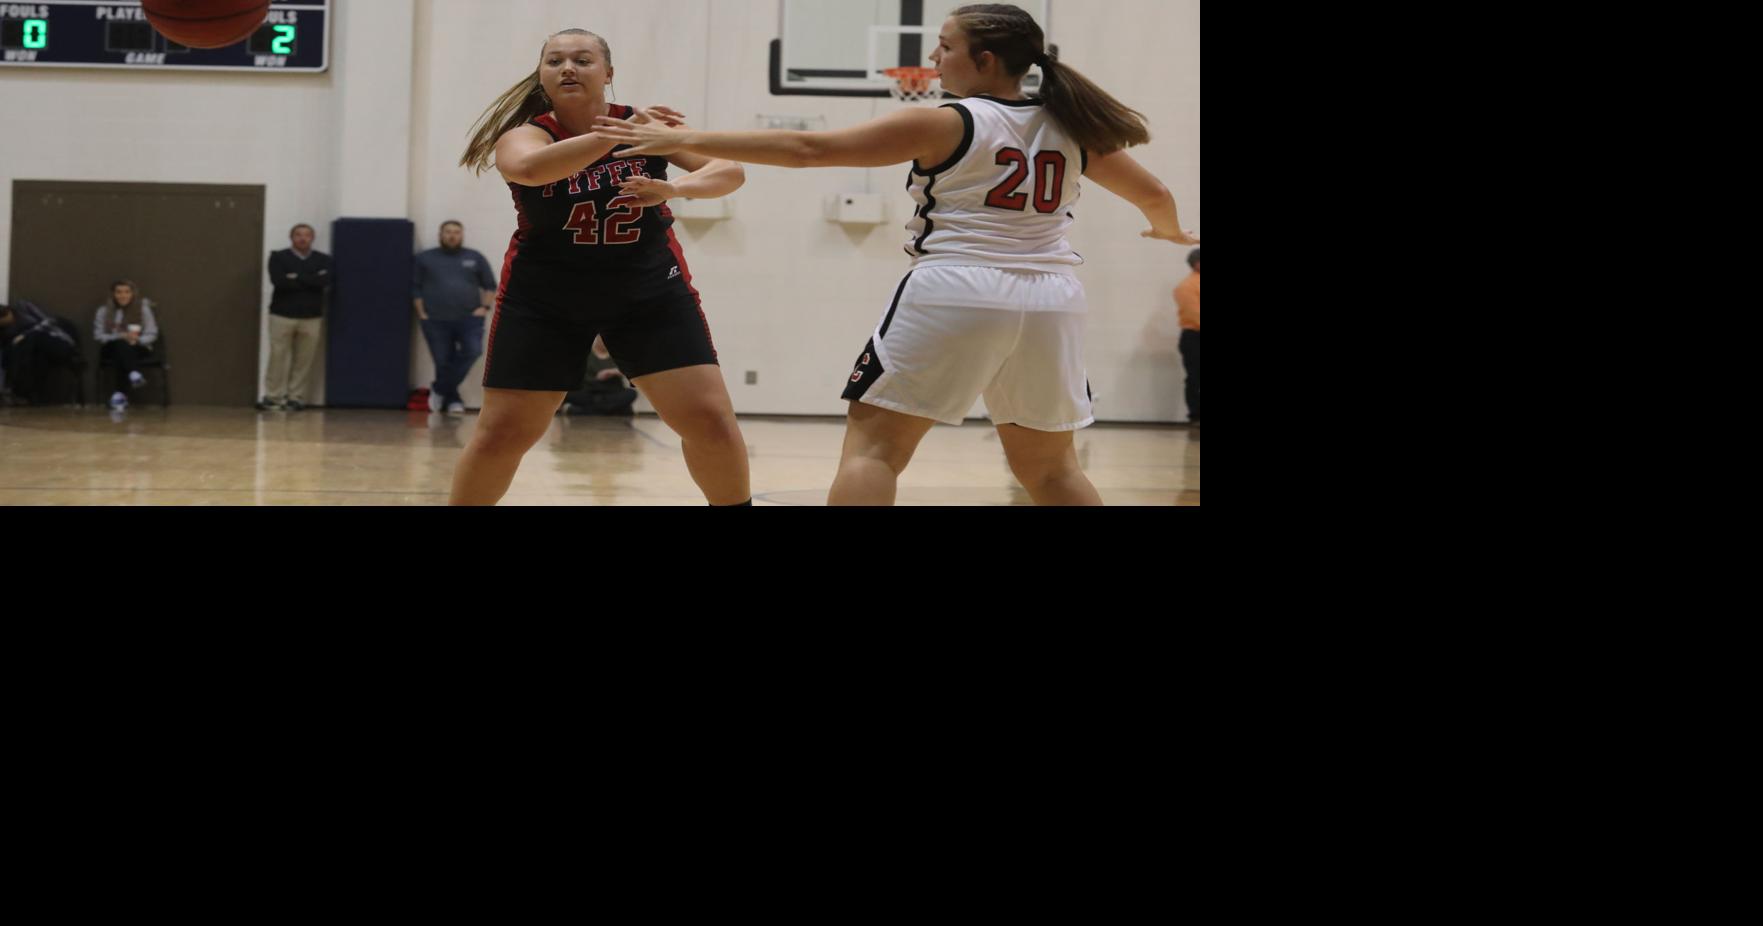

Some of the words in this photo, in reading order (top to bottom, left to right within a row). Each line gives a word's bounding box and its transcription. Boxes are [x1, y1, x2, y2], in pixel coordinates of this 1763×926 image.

[0, 4, 49, 18] FOULS
[96, 6, 147, 20] PLAYE
[22, 19, 47, 49] 0
[271, 24, 295, 55] 2
[4, 50, 38, 62] WON
[124, 51, 166, 65] GAME
[984, 146, 1066, 214] 20
[562, 194, 644, 245] 42
